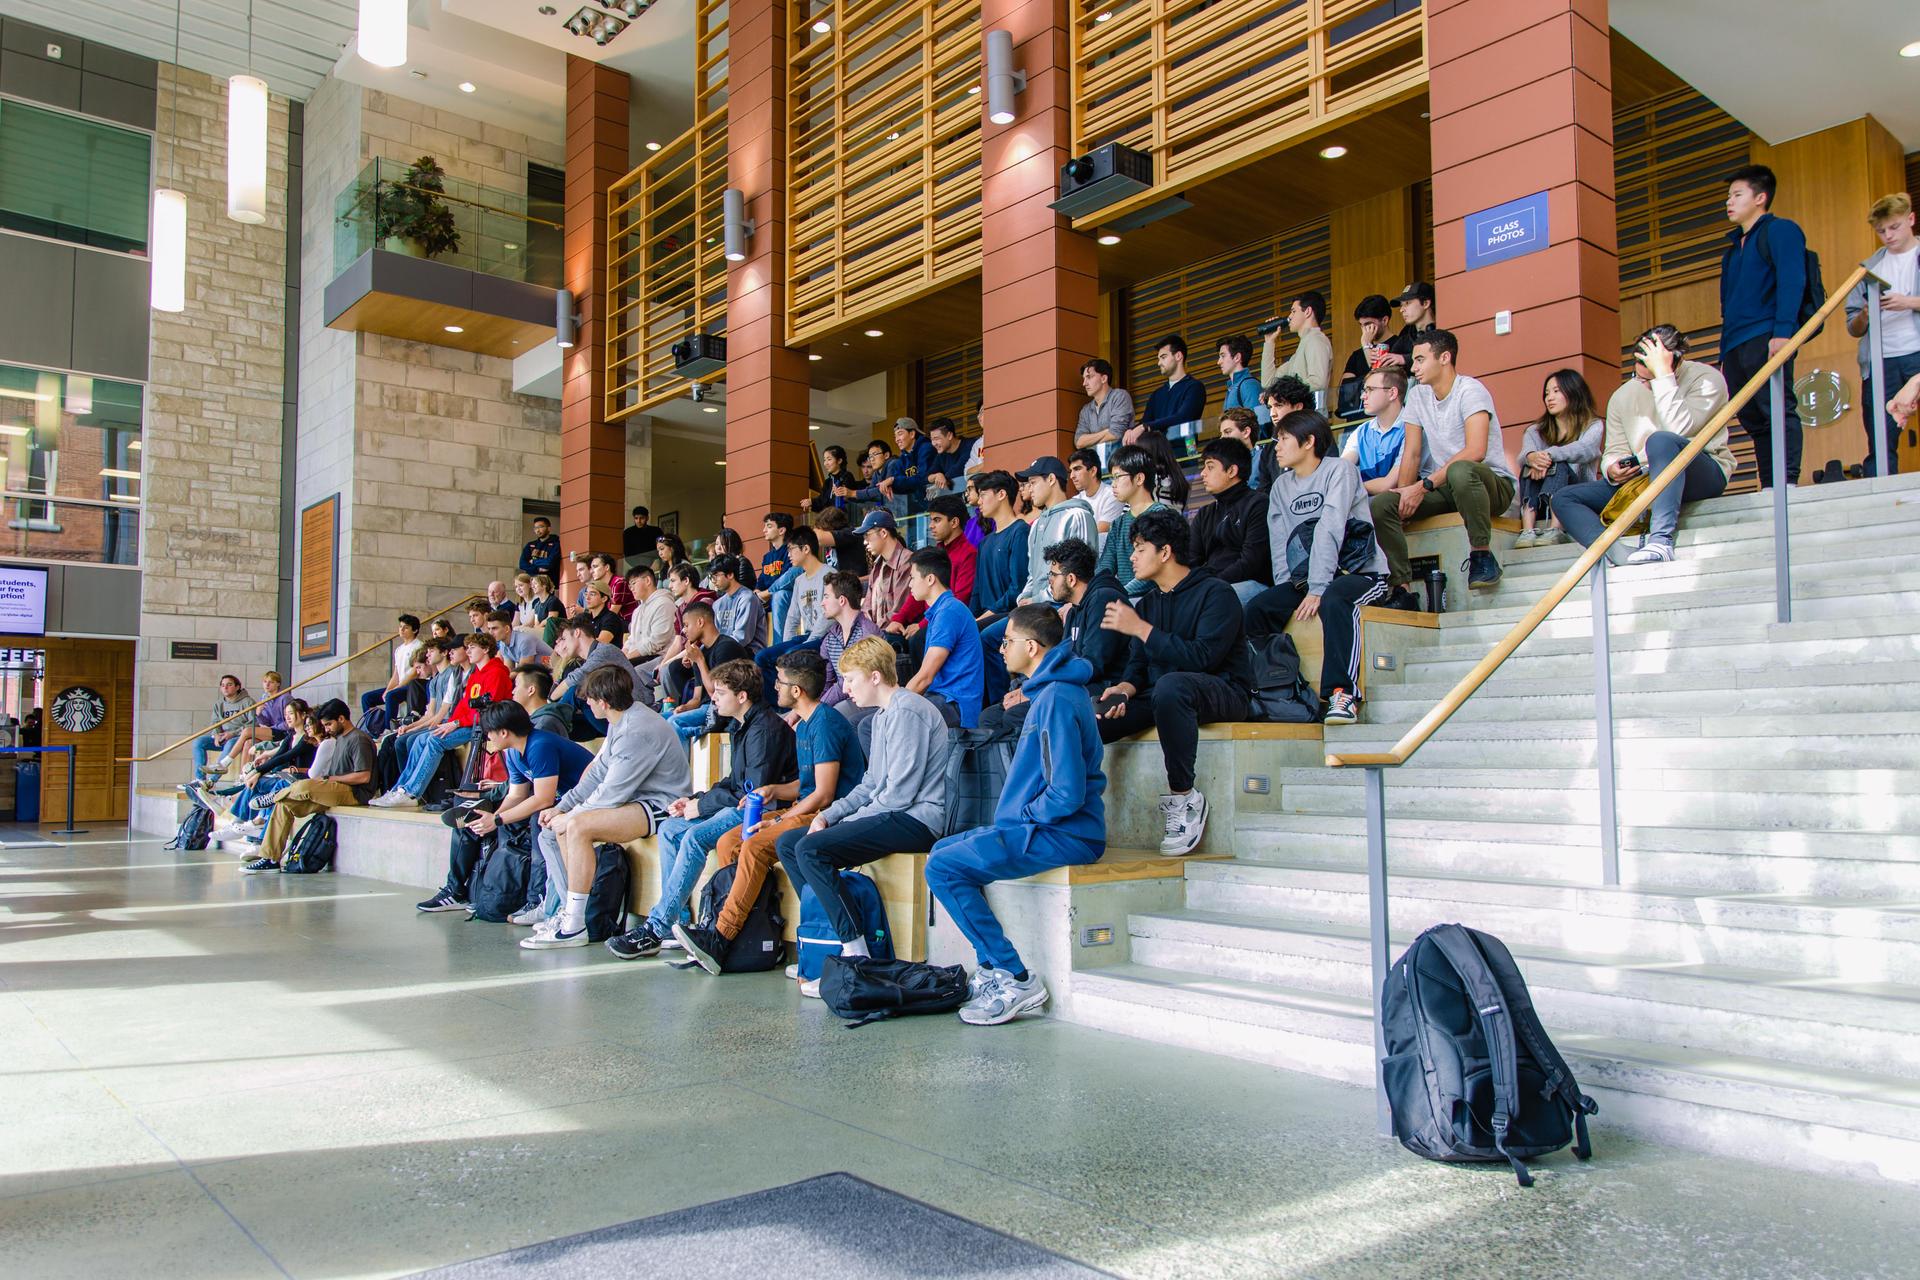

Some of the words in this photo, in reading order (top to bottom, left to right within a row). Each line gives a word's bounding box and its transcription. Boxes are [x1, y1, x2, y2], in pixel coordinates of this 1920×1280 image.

[1492, 220, 1520, 235] CLASS
[1487, 228, 1525, 246] PHOTOS
[1, 592, 25, 600] ption!
